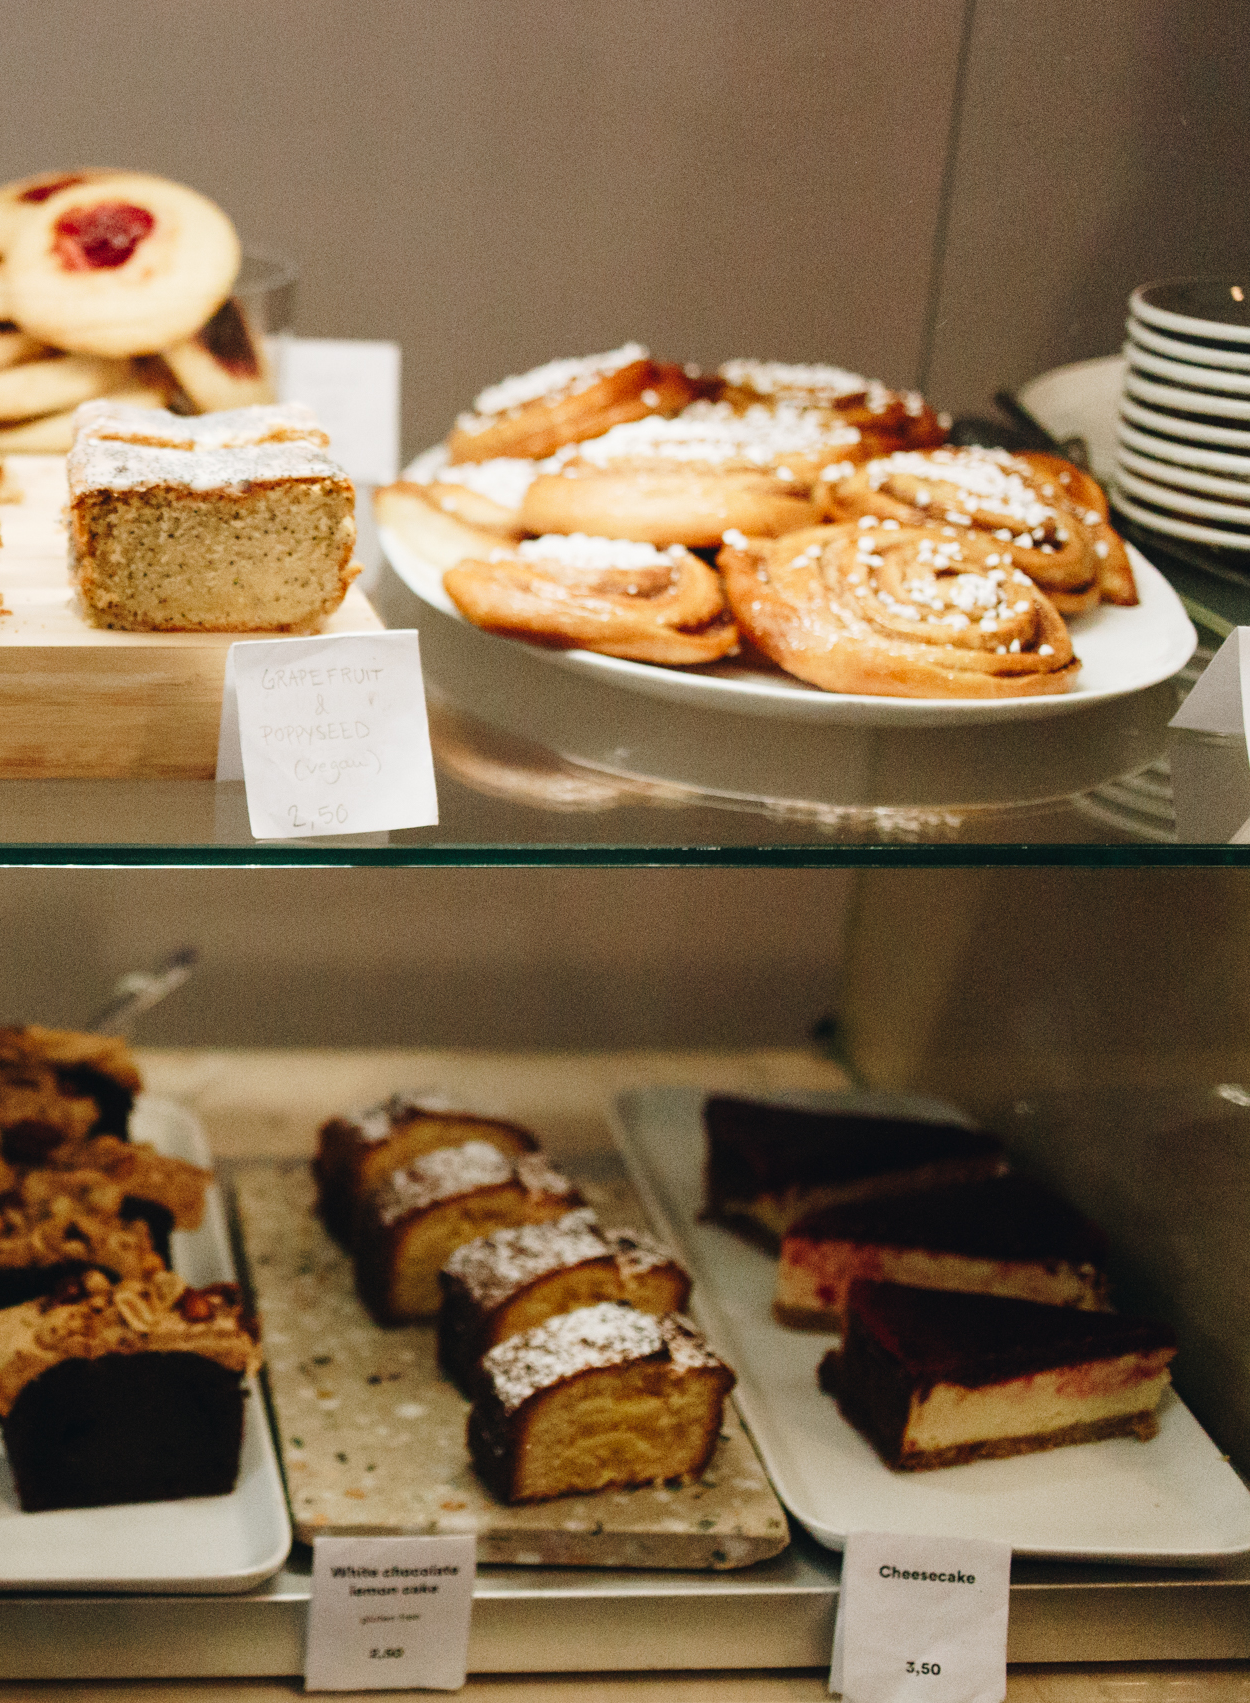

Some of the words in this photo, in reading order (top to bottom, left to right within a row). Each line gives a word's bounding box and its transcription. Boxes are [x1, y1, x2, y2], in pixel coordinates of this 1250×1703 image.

[315, 693, 330, 715] &
[259, 720, 370, 746] POPPYSEED
[294, 749, 382, 785] (vegan)
[288, 803, 349, 831] 2,50
[331, 1565, 378, 1578] White
[382, 1565, 459, 1578] chocolate
[879, 1565, 976, 1584] Cheesecake
[349, 1585, 398, 1597] lemon
[402, 1583, 439, 1596] cake
[905, 1661, 942, 1676] 3,50
